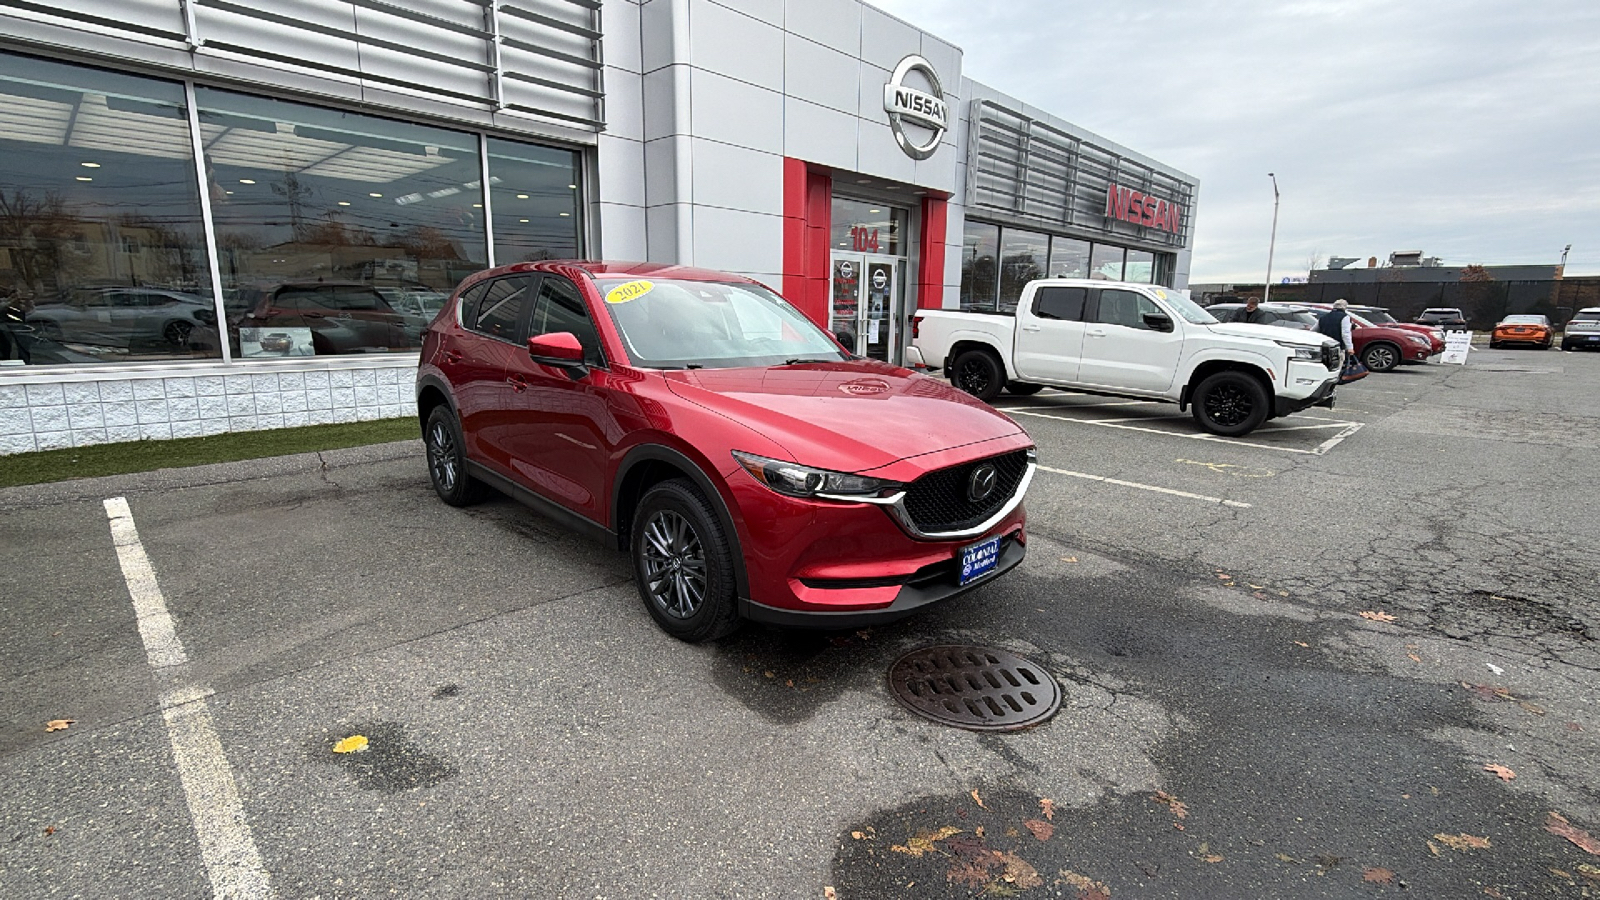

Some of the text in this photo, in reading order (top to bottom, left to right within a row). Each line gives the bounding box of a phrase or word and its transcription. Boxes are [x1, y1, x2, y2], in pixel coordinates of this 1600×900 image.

[895, 90, 948, 122] NISSAN
[1107, 183, 1180, 234] NISSAN
[851, 226, 879, 253] 104
[615, 282, 646, 300] 2021
